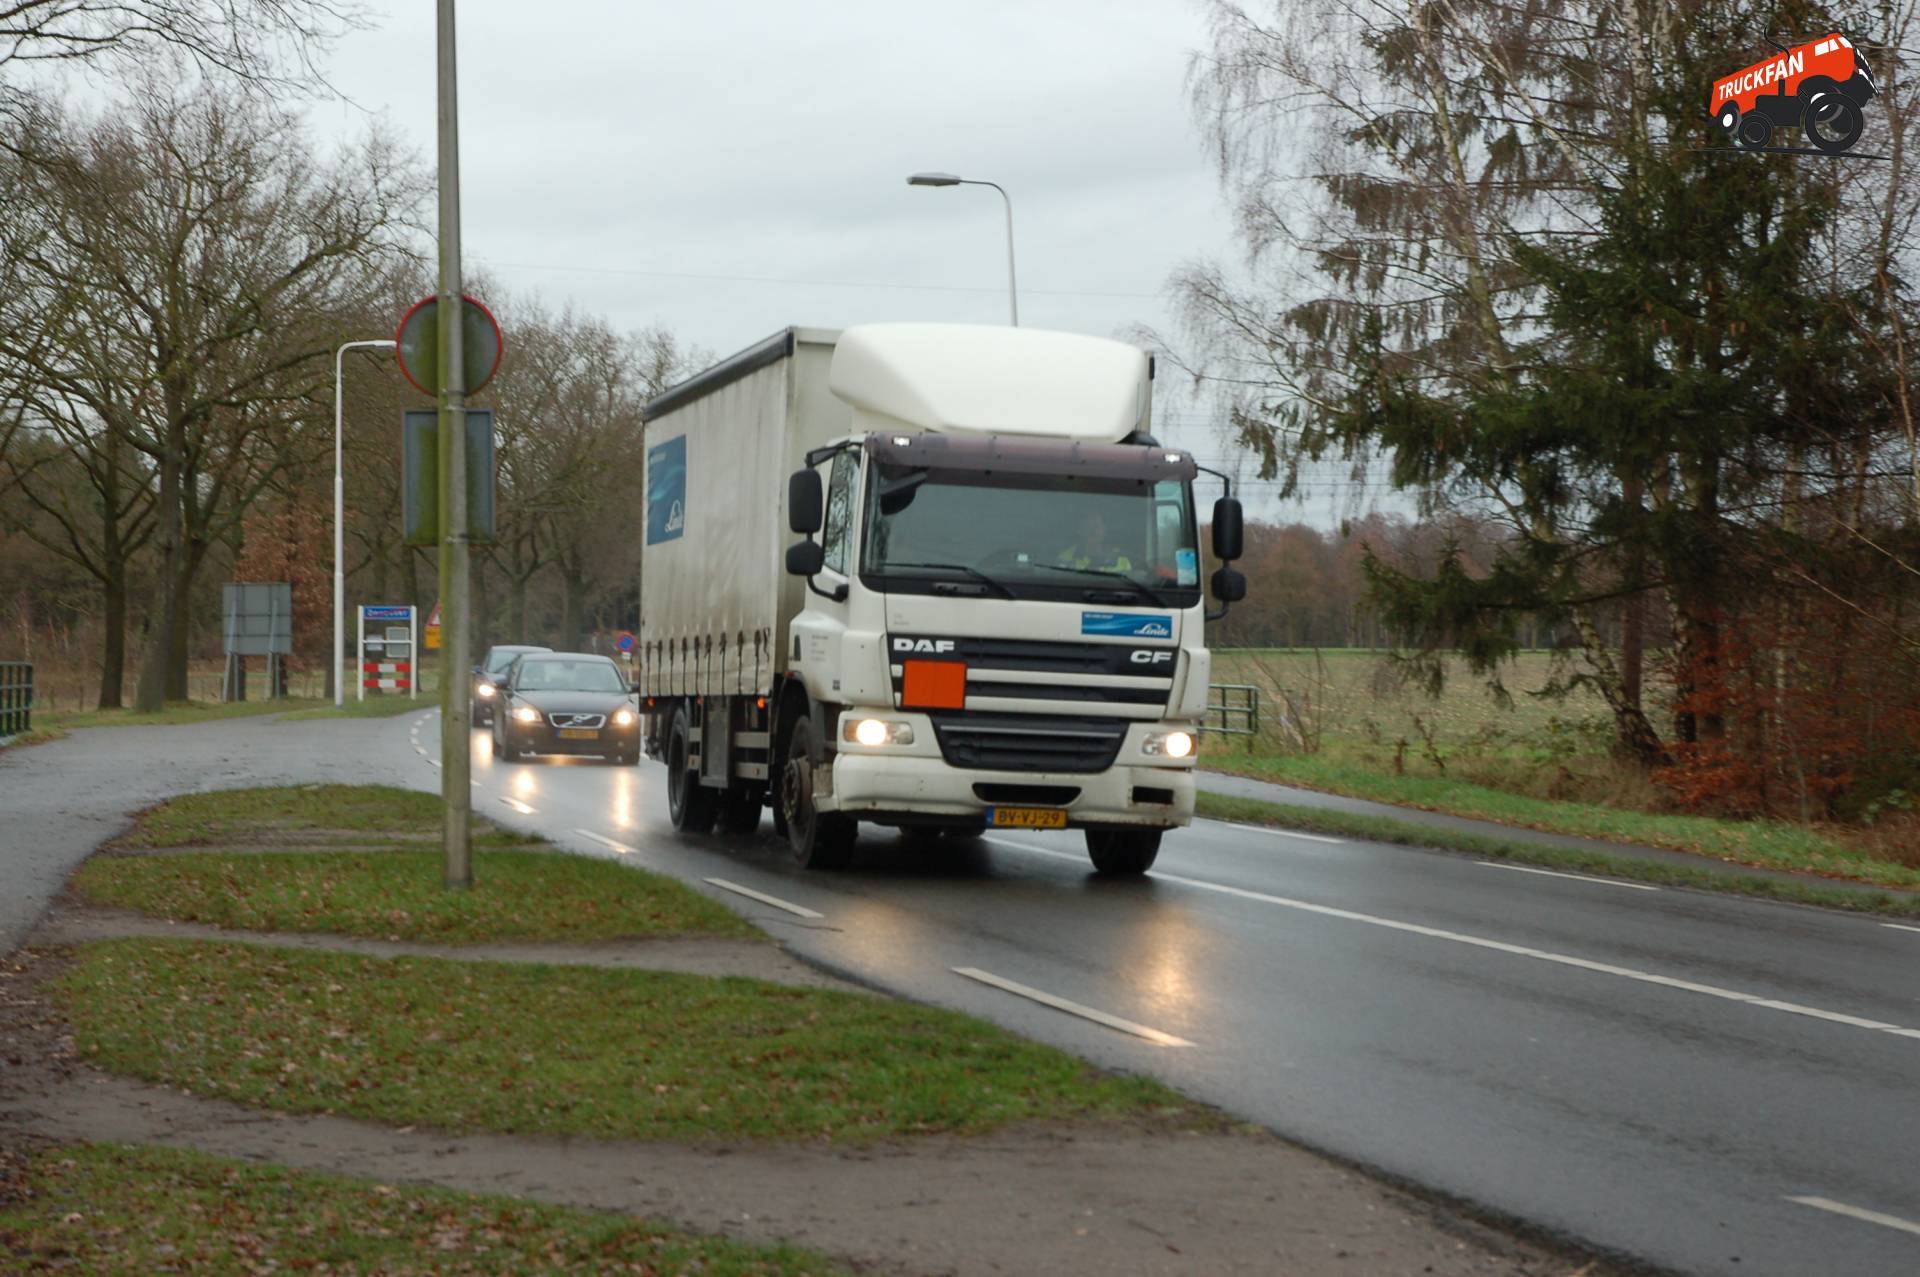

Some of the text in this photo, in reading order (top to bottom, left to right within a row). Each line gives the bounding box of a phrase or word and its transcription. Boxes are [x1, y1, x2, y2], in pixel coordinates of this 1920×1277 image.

[893, 638, 955, 653] DAF
[1130, 650, 1173, 664] CF
[998, 809, 1060, 825] BV-VJ-29
